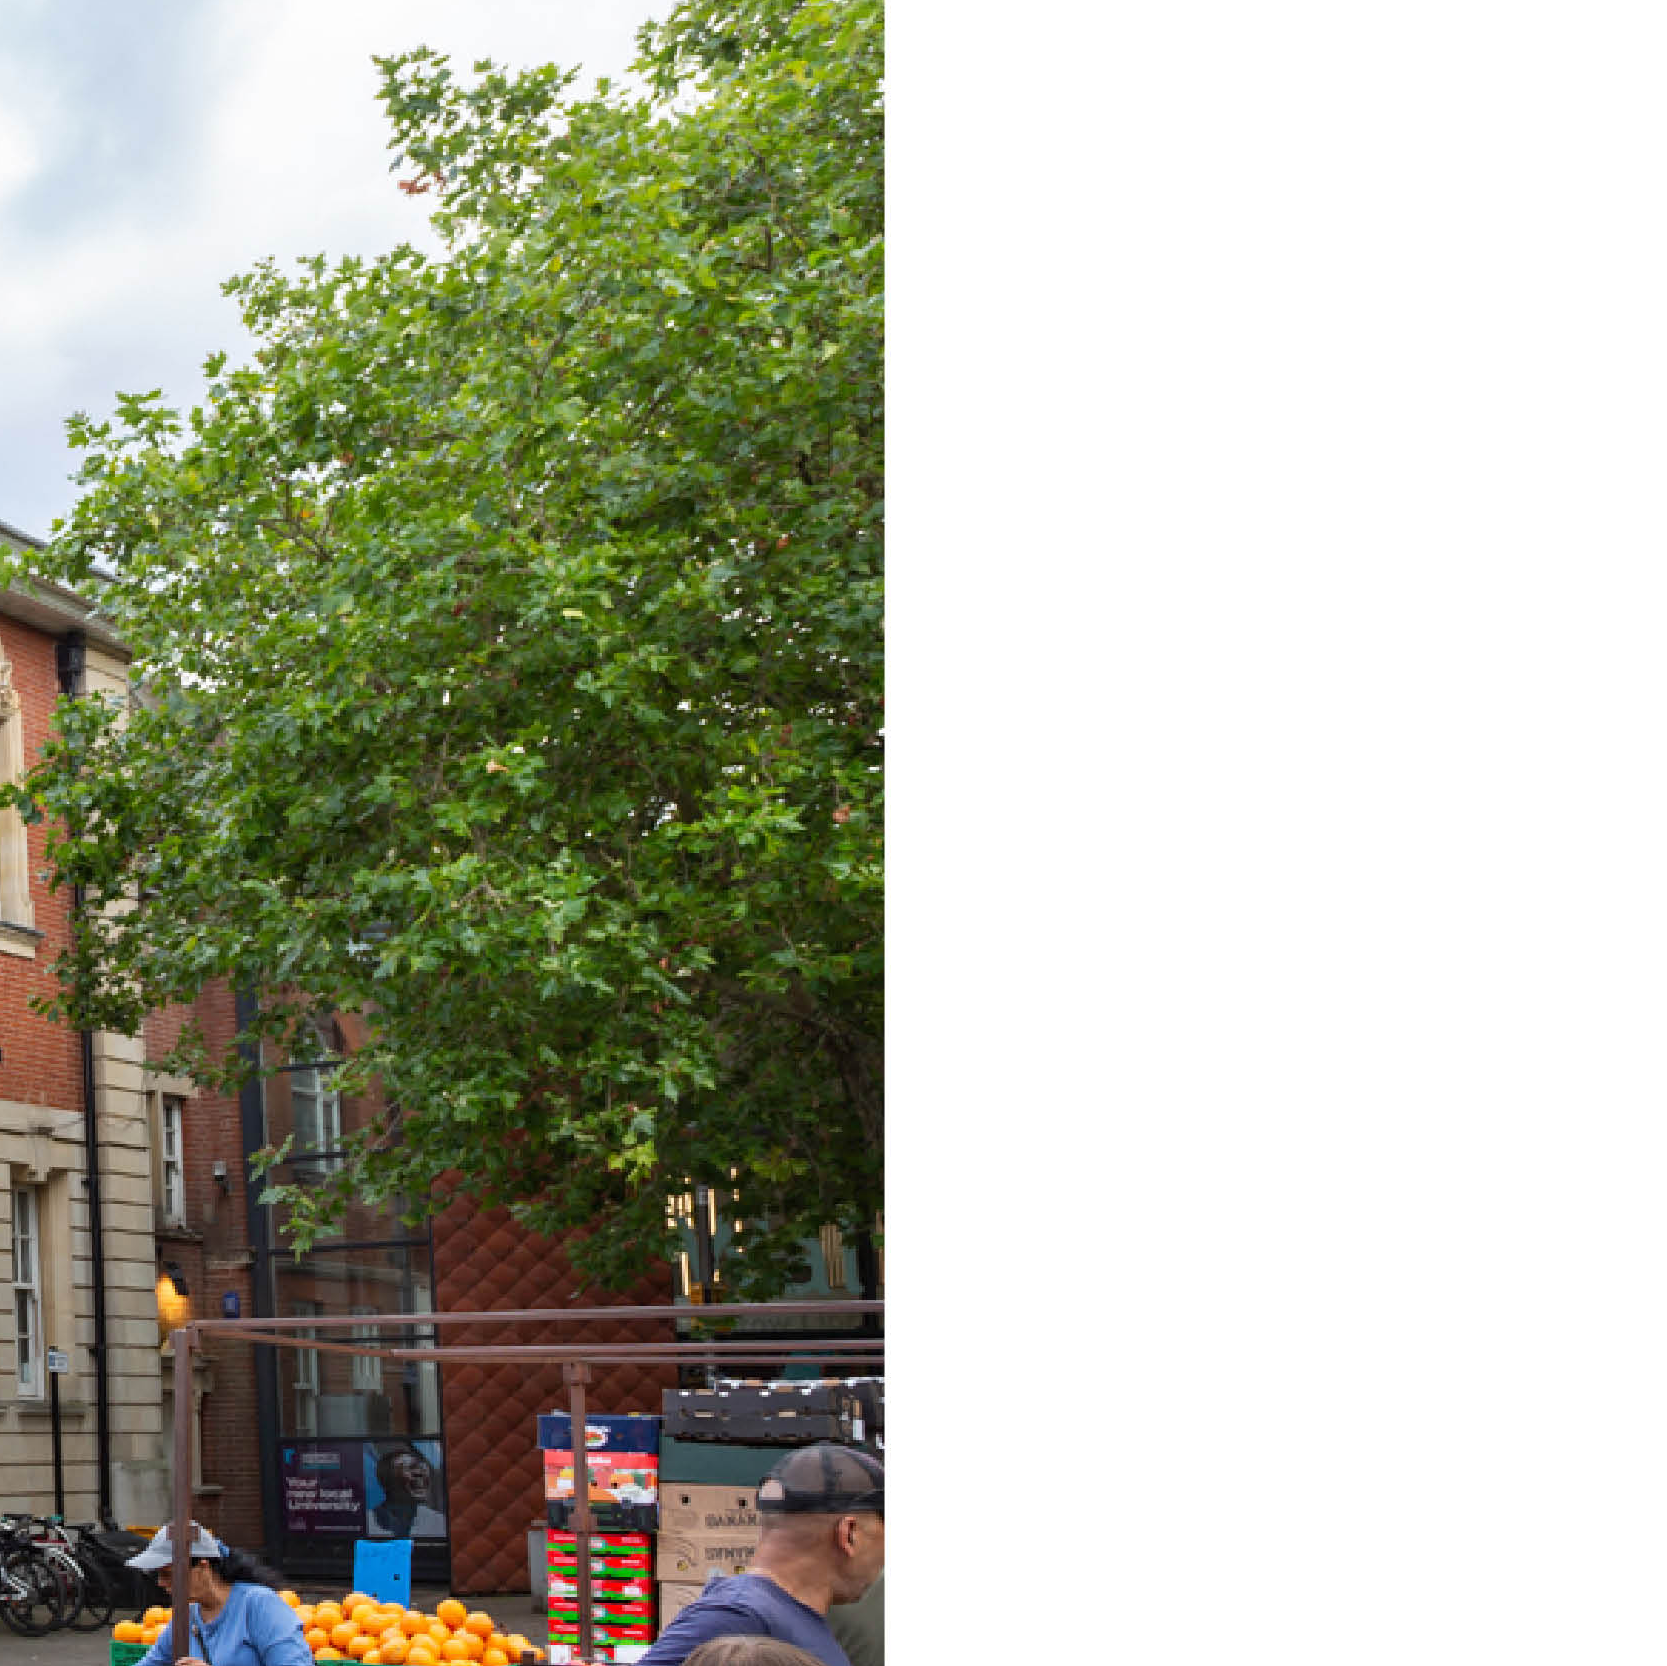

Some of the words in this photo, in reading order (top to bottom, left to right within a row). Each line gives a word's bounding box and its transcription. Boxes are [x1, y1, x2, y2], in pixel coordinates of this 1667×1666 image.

[285, 1476, 318, 1489] Your
[286, 1490, 316, 1499] new
[319, 1487, 353, 1499] local
[287, 1499, 362, 1513] University
